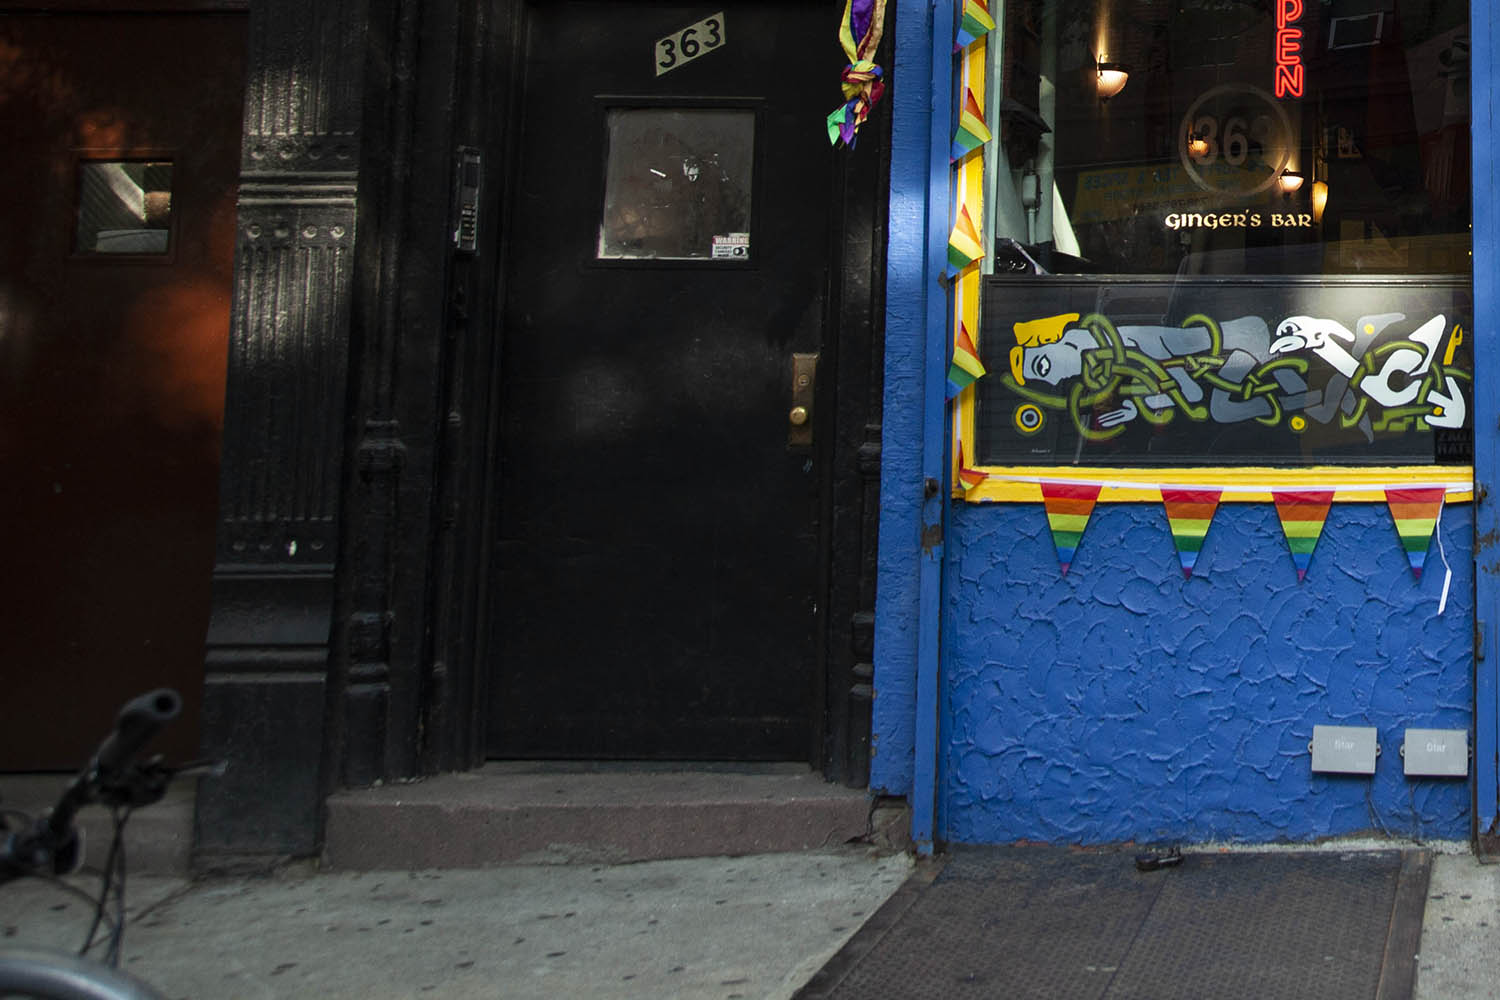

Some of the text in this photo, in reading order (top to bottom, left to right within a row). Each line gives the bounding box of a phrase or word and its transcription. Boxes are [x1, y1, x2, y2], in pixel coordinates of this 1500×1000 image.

[658, 18, 721, 69] 363
[1164, 208, 1313, 231] GINGER'S BAR
